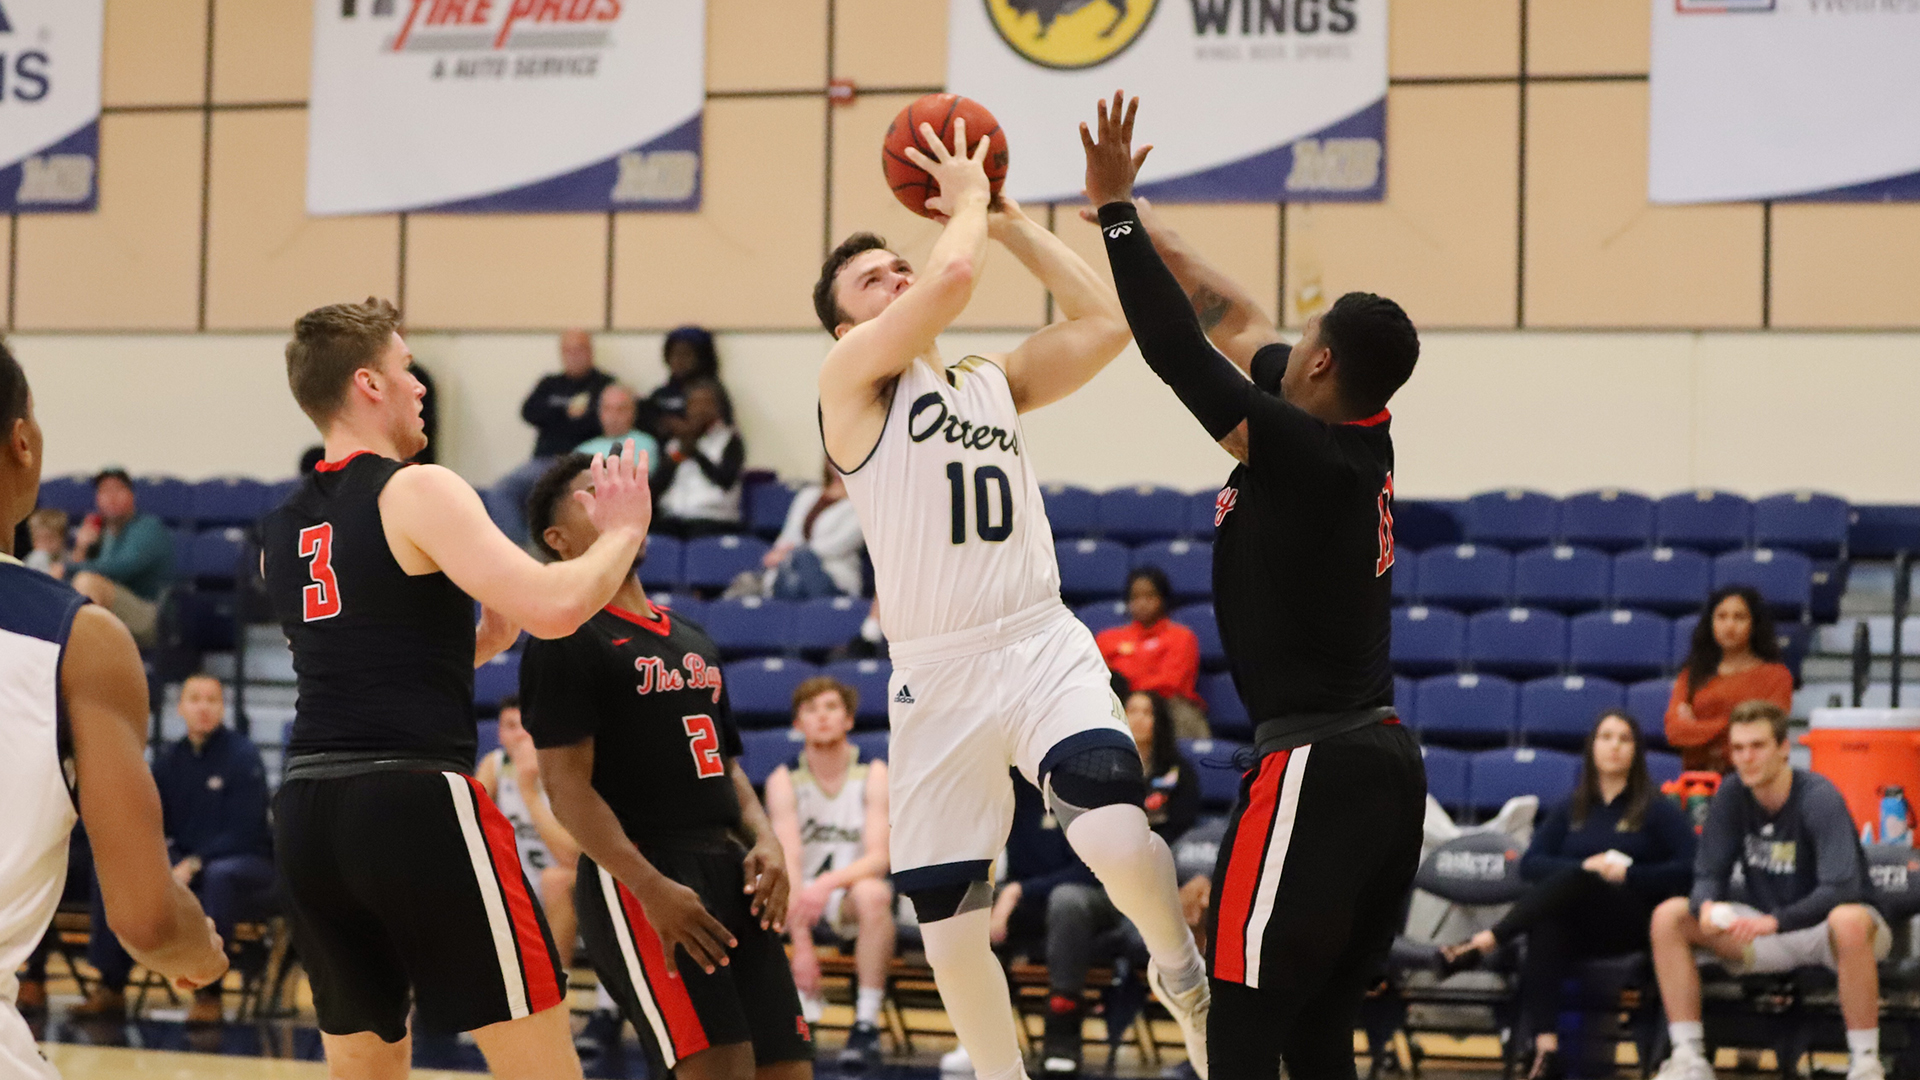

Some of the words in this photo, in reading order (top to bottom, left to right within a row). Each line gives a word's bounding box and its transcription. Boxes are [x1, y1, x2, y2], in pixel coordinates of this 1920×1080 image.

[391, 0, 493, 50] TIRE
[1192, 0, 1358, 35] WINGS
[454, 58, 507, 77] AUTO
[514, 56, 599, 77] SERVICE
[908, 391, 1019, 457] Otters
[946, 461, 1014, 545] 10
[299, 521, 342, 623] 3
[635, 655, 684, 695] The
[682, 652, 723, 704] Bay
[682, 714, 725, 779] 2
